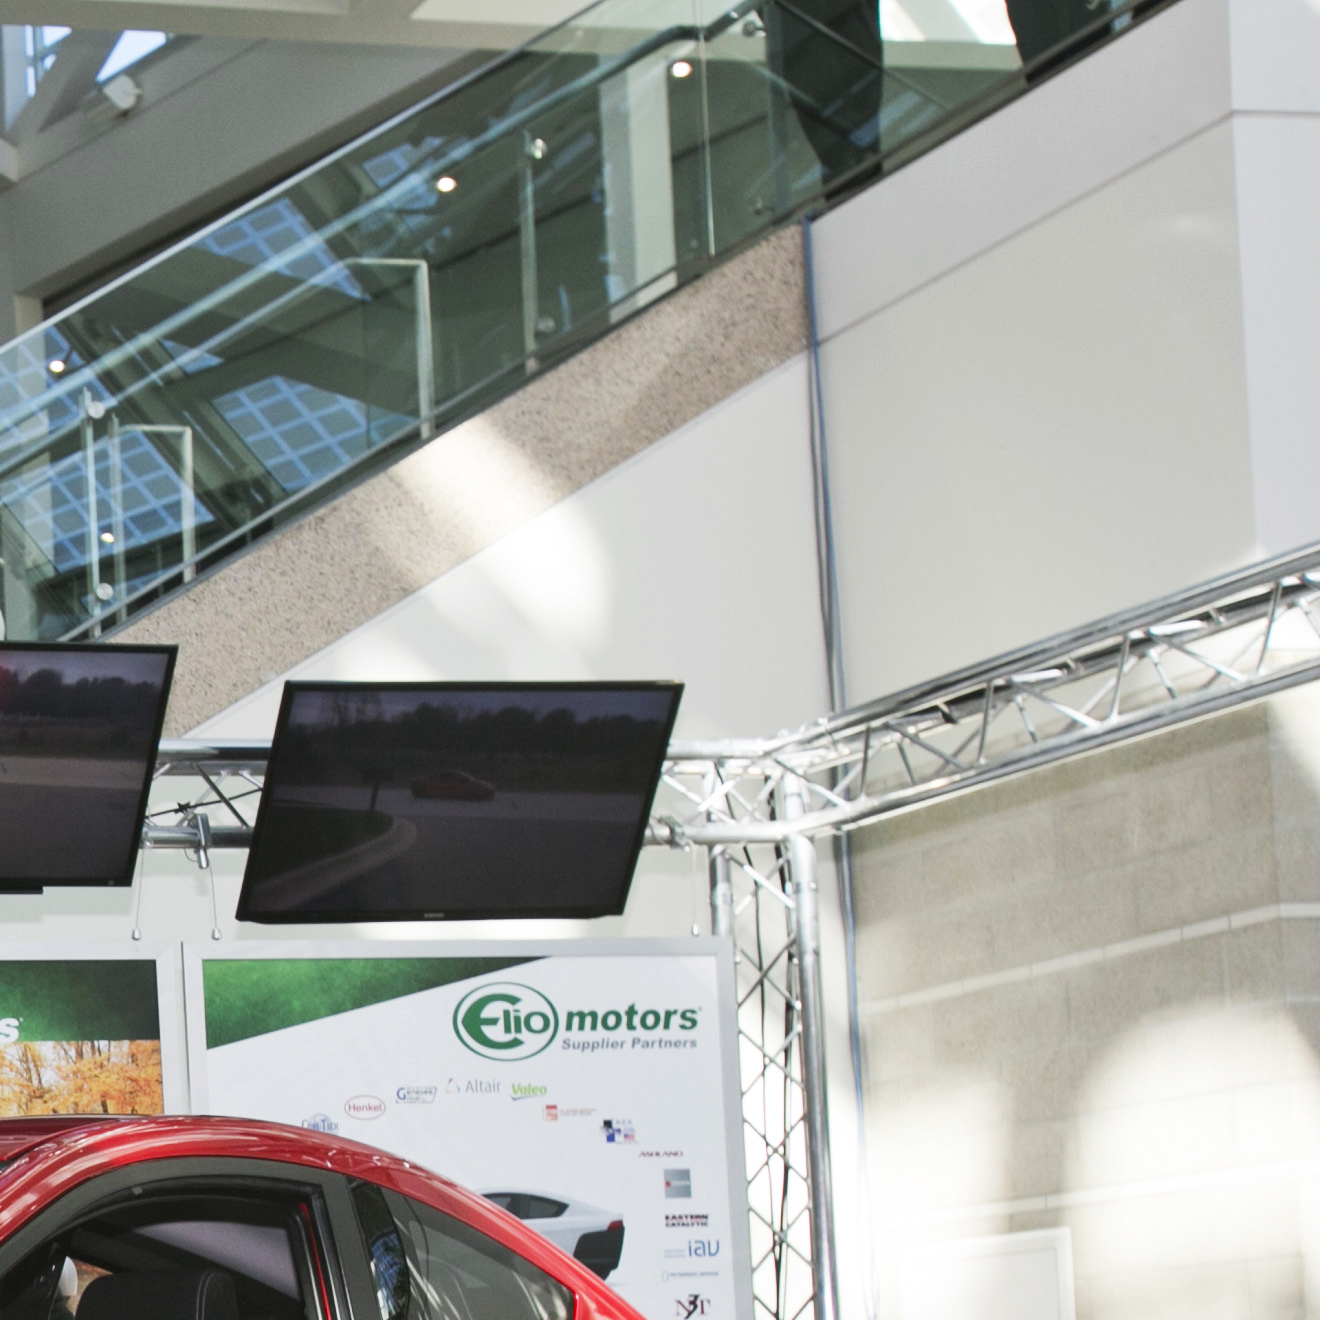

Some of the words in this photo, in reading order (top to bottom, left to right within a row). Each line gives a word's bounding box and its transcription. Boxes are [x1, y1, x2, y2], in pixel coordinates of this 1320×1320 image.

[461, 993, 551, 1050] Elio
[565, 1003, 698, 1031] motors
[561, 1037, 625, 1052] Supplier
[631, 1037, 697, 1049] Partners
[465, 1079, 501, 1094] Altair
[511, 1083, 547, 1096] Valeo
[348, 1102, 382, 1113] Henkel
